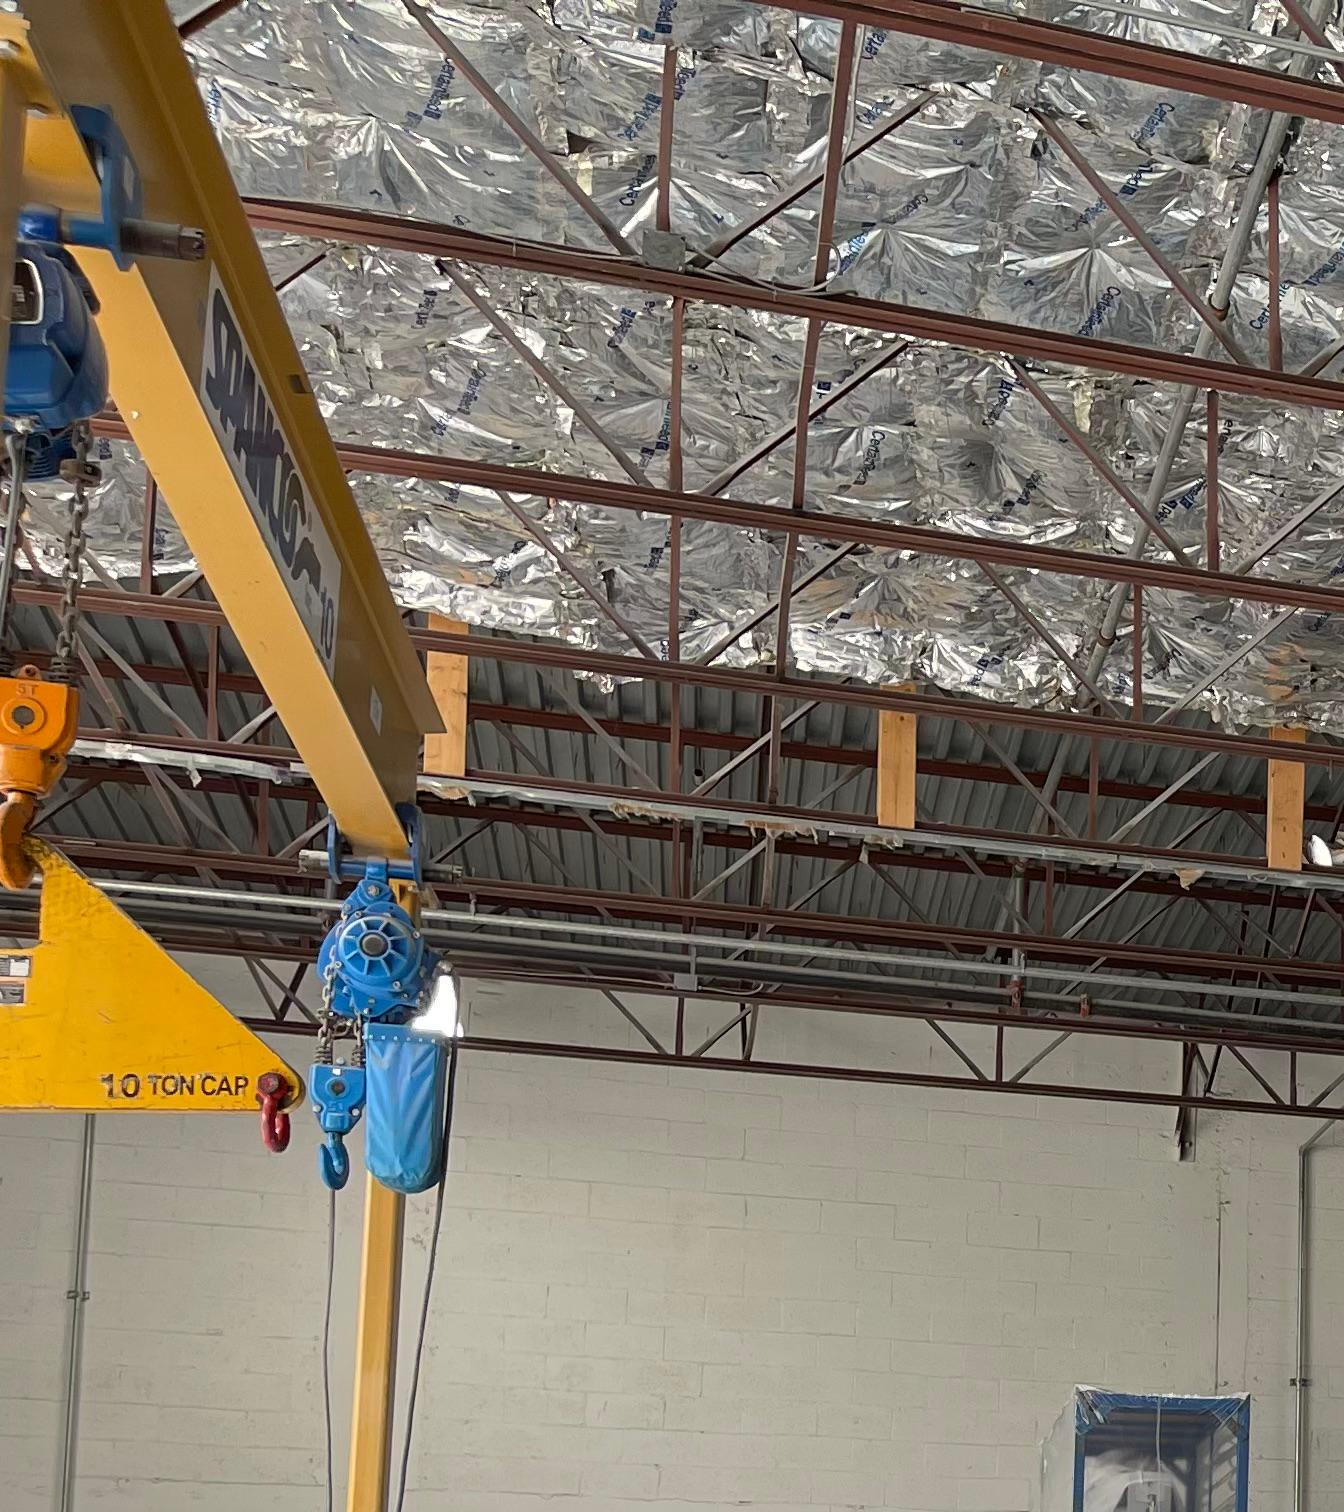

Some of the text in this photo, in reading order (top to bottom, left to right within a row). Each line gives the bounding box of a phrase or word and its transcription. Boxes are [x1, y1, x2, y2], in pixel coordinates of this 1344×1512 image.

[101, 1073, 250, 1098] 10 TON CAP
